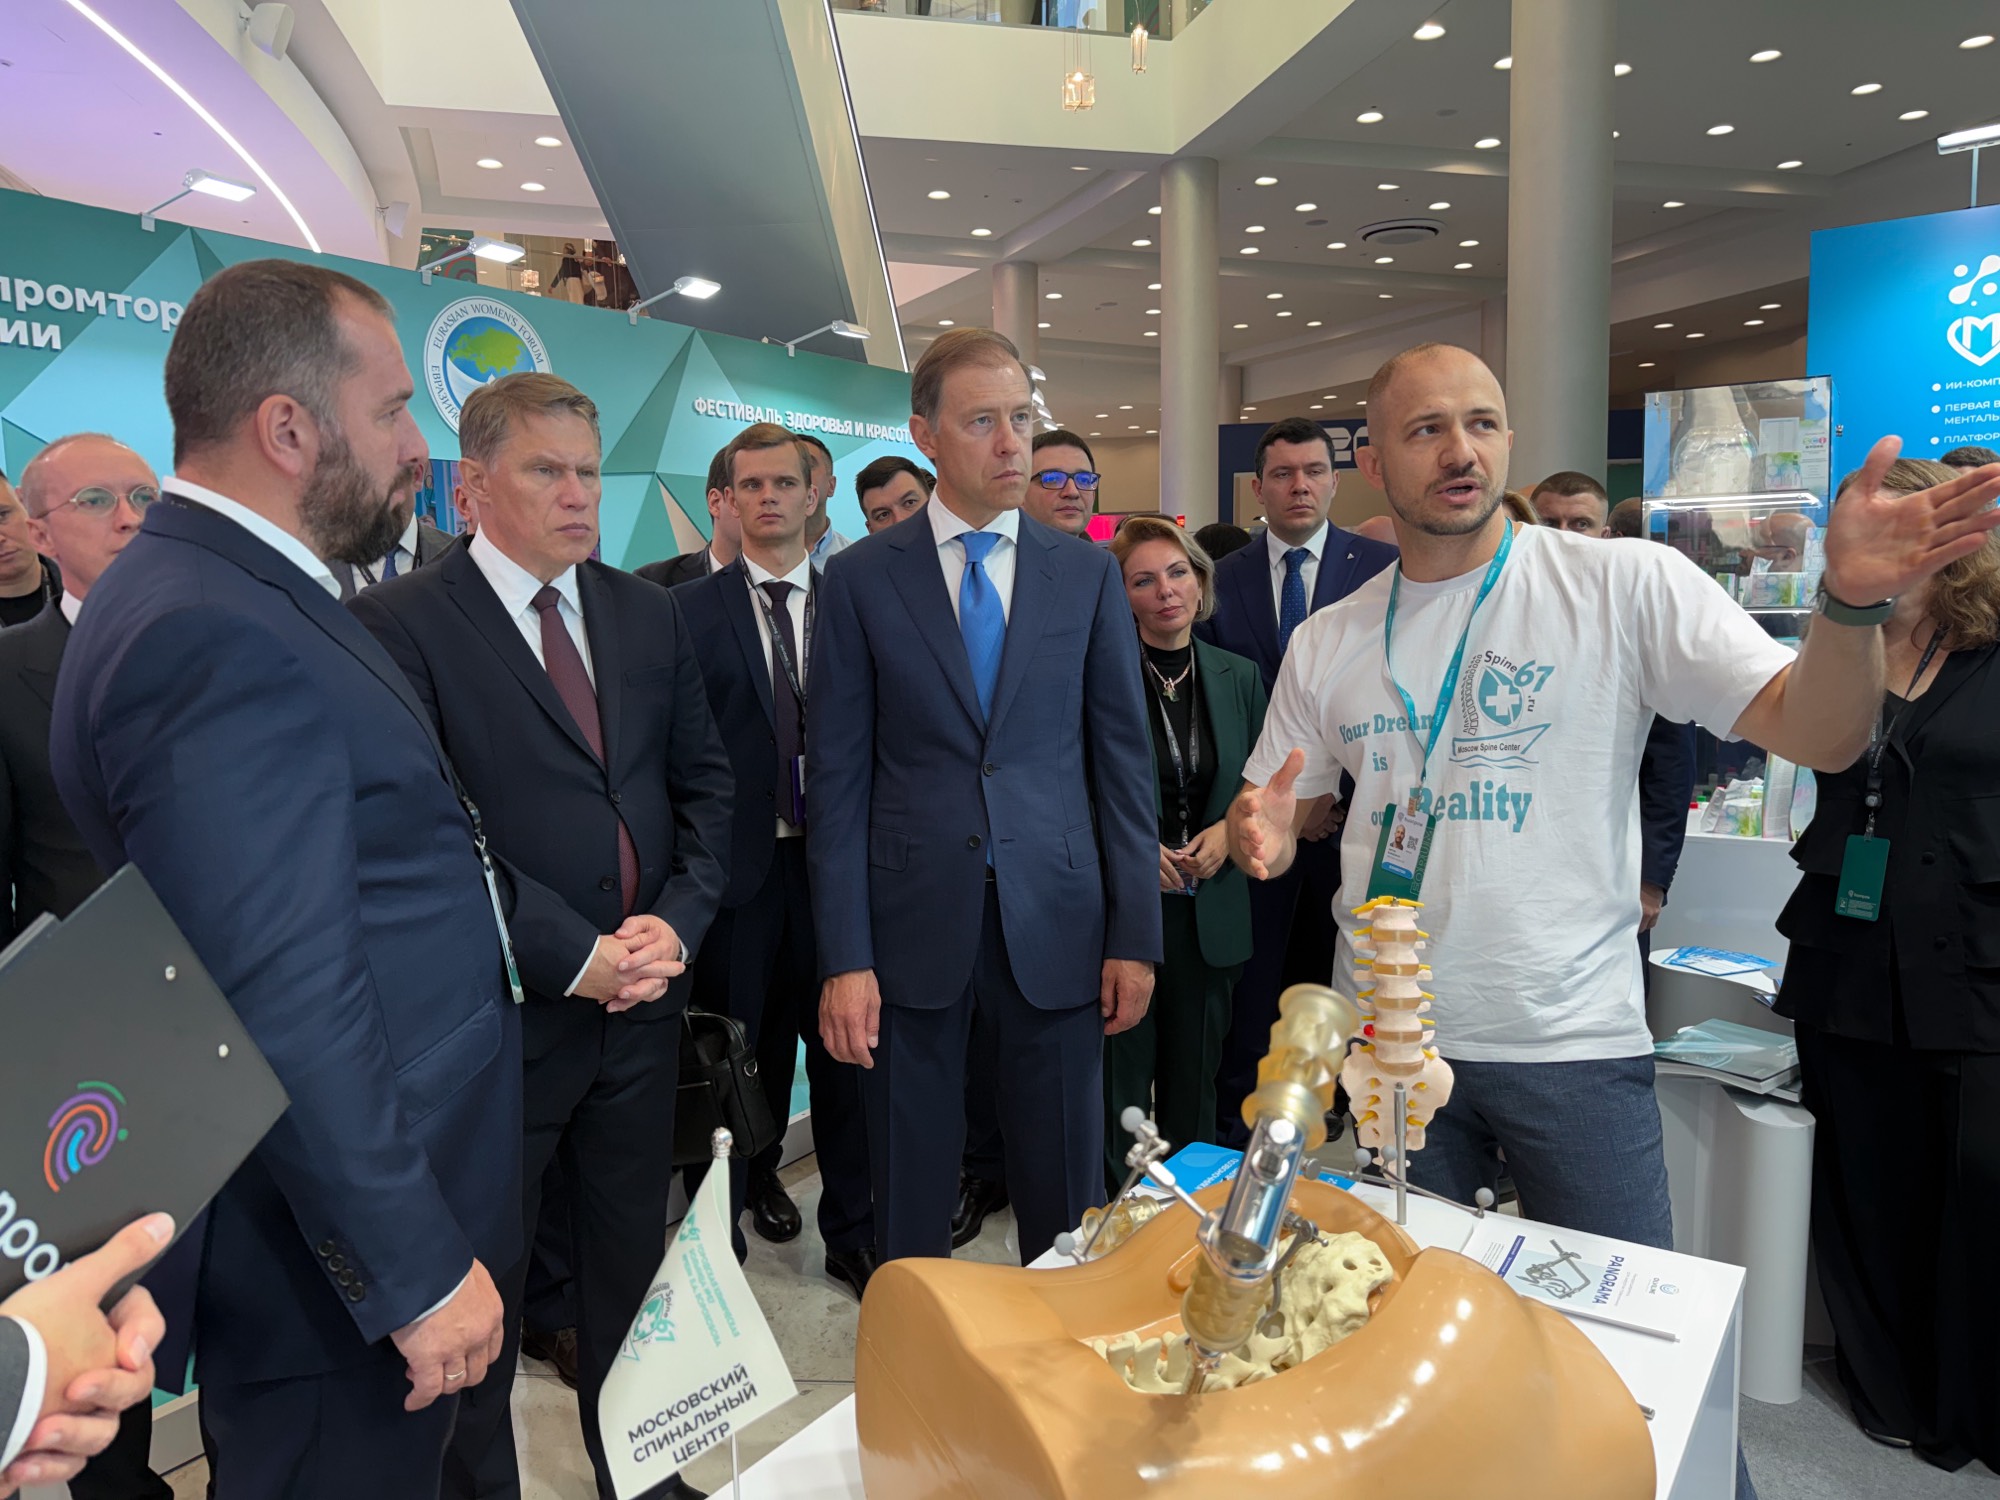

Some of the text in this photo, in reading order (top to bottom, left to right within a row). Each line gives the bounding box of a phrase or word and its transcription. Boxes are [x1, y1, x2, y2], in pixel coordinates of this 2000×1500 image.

[433, 303, 544, 364] EURASIAN WOMEN'S FORUM
[693, 397, 783, 425] ФЕСТИВАЛЬ
[785, 411, 852, 435] ЗДОРОВЬЯ
[854, 421, 864, 436] И
[1944, 413, 2000, 425] МЕНТАЛЬ
[1945, 400, 1990, 412] ПЕРВАЯ
[1484, 650, 1555, 693] Spine 67
[1339, 721, 1370, 744] Your
[1457, 742, 1520, 754] Moscow Spine Center
[1372, 751, 1388, 772] is
[1592, 1254, 1625, 1305] PANORAMA
[664, 1289, 674, 1318] Spine
[627, 1362, 748, 1444] МОСКОВСКИЙ
[633, 1380, 758, 1463] СПИНАЛЬНЫЙ
[672, 1421, 730, 1464] ЦЕНТР
